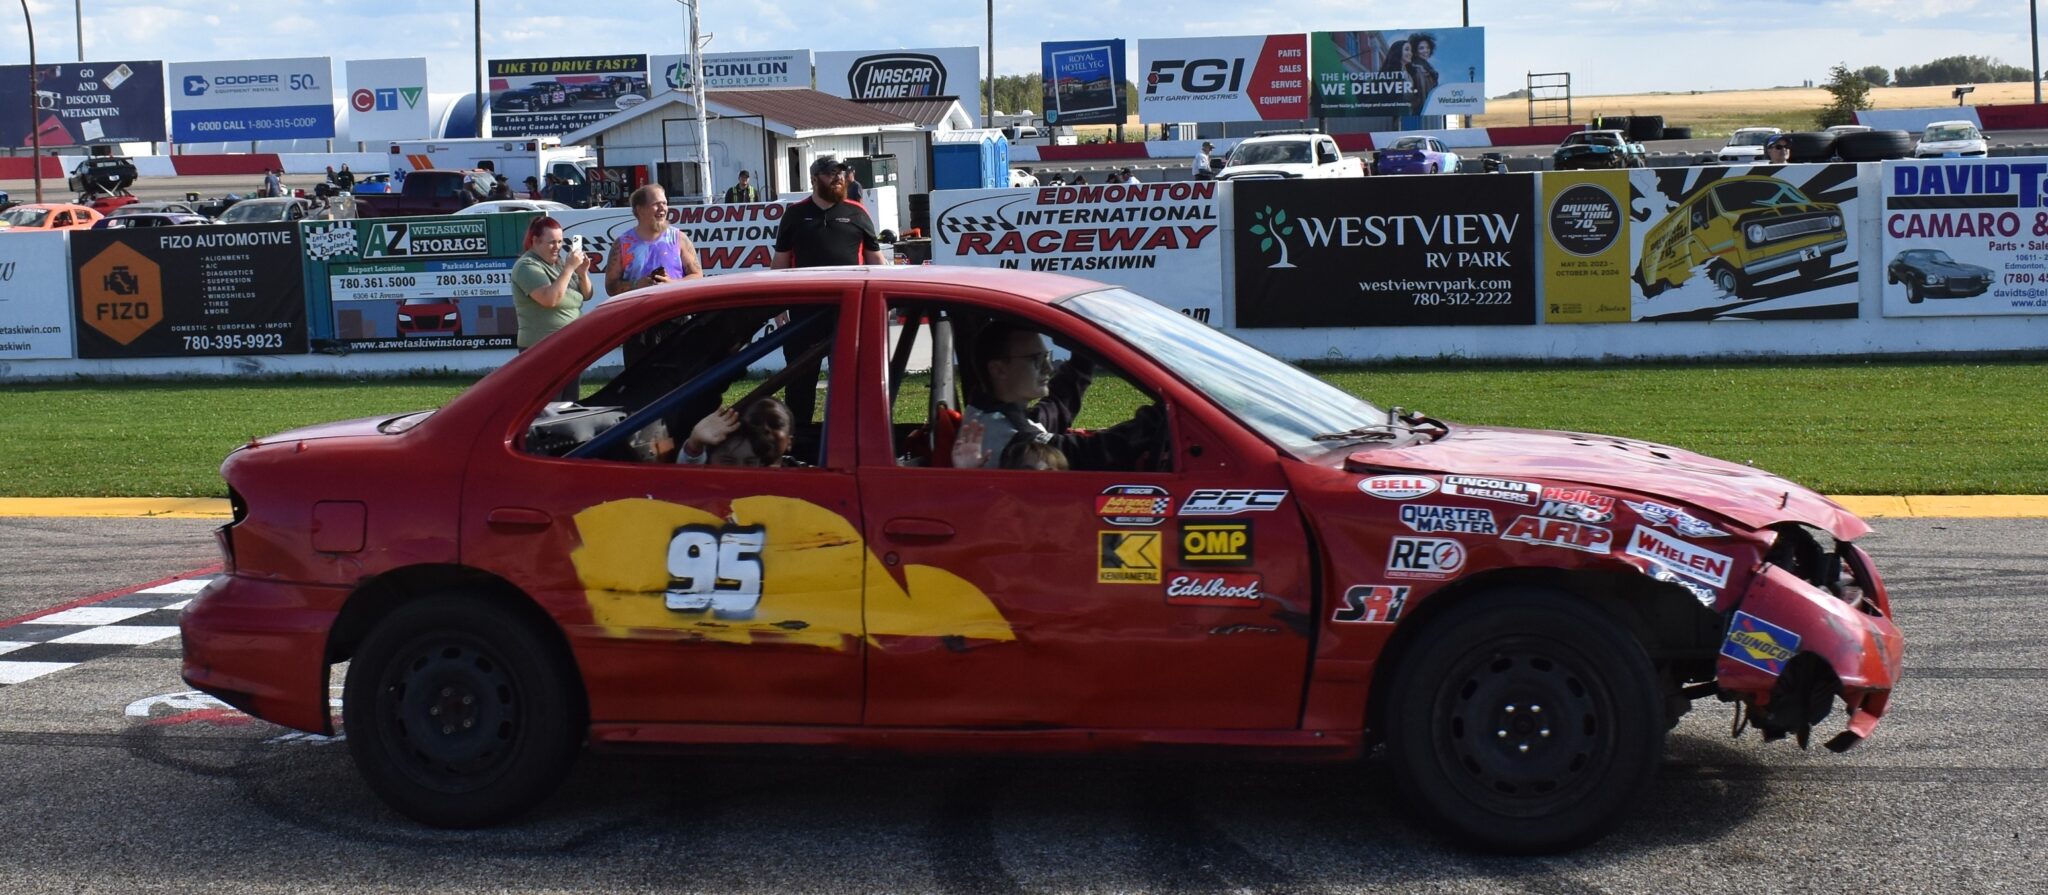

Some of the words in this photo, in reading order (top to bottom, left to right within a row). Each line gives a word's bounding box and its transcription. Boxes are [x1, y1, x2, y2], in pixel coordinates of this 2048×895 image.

[1069, 53, 1095, 62] ROYAL
[1278, 49, 1301, 57] PARTS
[80, 69, 94, 78] GO
[497, 62, 526, 74] LIKE
[531, 62, 548, 73] TO
[552, 60, 592, 72] DRIVE
[596, 58, 637, 70] FAST?
[703, 62, 787, 77] CONLON
[1061, 63, 1087, 72] HOTEL
[1279, 65, 1302, 73] SALES
[214, 75, 279, 85] COOPER
[290, 74, 314, 91] 50
[703, 76, 788, 86] MOTORSPORTS
[871, 67, 932, 84] NASCAR
[1146, 58, 1245, 94] FGI
[1320, 73, 1339, 82] THE
[1342, 71, 1406, 81] HOSPITALITY
[77, 82, 98, 92] AND
[863, 80, 909, 98] HOME
[1271, 80, 1302, 89] SERVICE
[1321, 83, 1346, 95] WE
[1351, 81, 1418, 95] DELIVER.
[66, 95, 111, 105] DISCOVER
[354, 89, 422, 110] CTV
[1260, 96, 1302, 105] EQUIPMENT
[60, 107, 120, 118] WETASKIWIN
[197, 121, 221, 131] GOOD
[223, 120, 246, 130] CALL
[248, 117, 317, 129] 1-800-315-COOP
[1894, 164, 2010, 195] DAVID
[2011, 163, 2048, 208] T
[1036, 182, 1216, 206] EDMONTON
[667, 203, 786, 224] DMONTO
[1016, 204, 1217, 226] INTERNATIONAL
[1561, 203, 1610, 216] DRIVING
[1583, 211, 1613, 220] THRU
[411, 224, 483, 235] WETASKIWIN
[1297, 213, 1520, 247] WESTVIEW
[1887, 212, 2020, 239] CAMARO
[160, 235, 192, 249] FIZO
[195, 231, 291, 248] AUTOMOTIVE
[364, 223, 408, 257] AZ
[412, 237, 486, 252] STORAGE
[956, 225, 1218, 256] RACEWAY
[1989, 241, 2017, 251] Parts
[205, 254, 250, 262] ALIGNMENTS
[442, 262, 474, 270] Parkside
[475, 261, 506, 269] Location
[1000, 257, 1018, 270] IN
[1031, 254, 1156, 271] WETASKIWIN
[1426, 252, 1451, 268] RV
[1458, 251, 1512, 267] PARK
[206, 269, 254, 277] DIAGNOSTICS
[348, 266, 373, 274] Airport
[374, 264, 405, 272] Location
[2005, 262, 2046, 270] Edmonton,
[339, 276, 416, 289] 780.361.5000
[1359, 277, 1512, 292] westviewrvpark.com
[2004, 273, 2034, 285] (780)
[479, 288, 500, 296] Street
[1412, 292, 1512, 306] 780-312-2222
[2011, 299, 2048, 307] www.da
[96, 302, 149, 321] FIZO
[182, 333, 283, 350] 780-395-9923
[351, 337, 512, 350] www.azwetaskiwinstorage.com
[1371, 479, 1427, 490] BELL
[1449, 476, 1524, 492] LINCOLN
[1185, 490, 1286, 506] PFC
[1462, 487, 1529, 503] WELDERS
[1543, 487, 1615, 513] Holley
[1402, 506, 1491, 522] QUARTER
[1417, 518, 1496, 534] MASTER
[1506, 517, 1610, 548] ARP
[1184, 531, 1247, 553] OMP
[1637, 530, 1728, 577] WHELEN
[665, 522, 767, 619] 95
[1167, 576, 1259, 600] Edelbrock
[1732, 631, 1793, 660] SUNOCO
